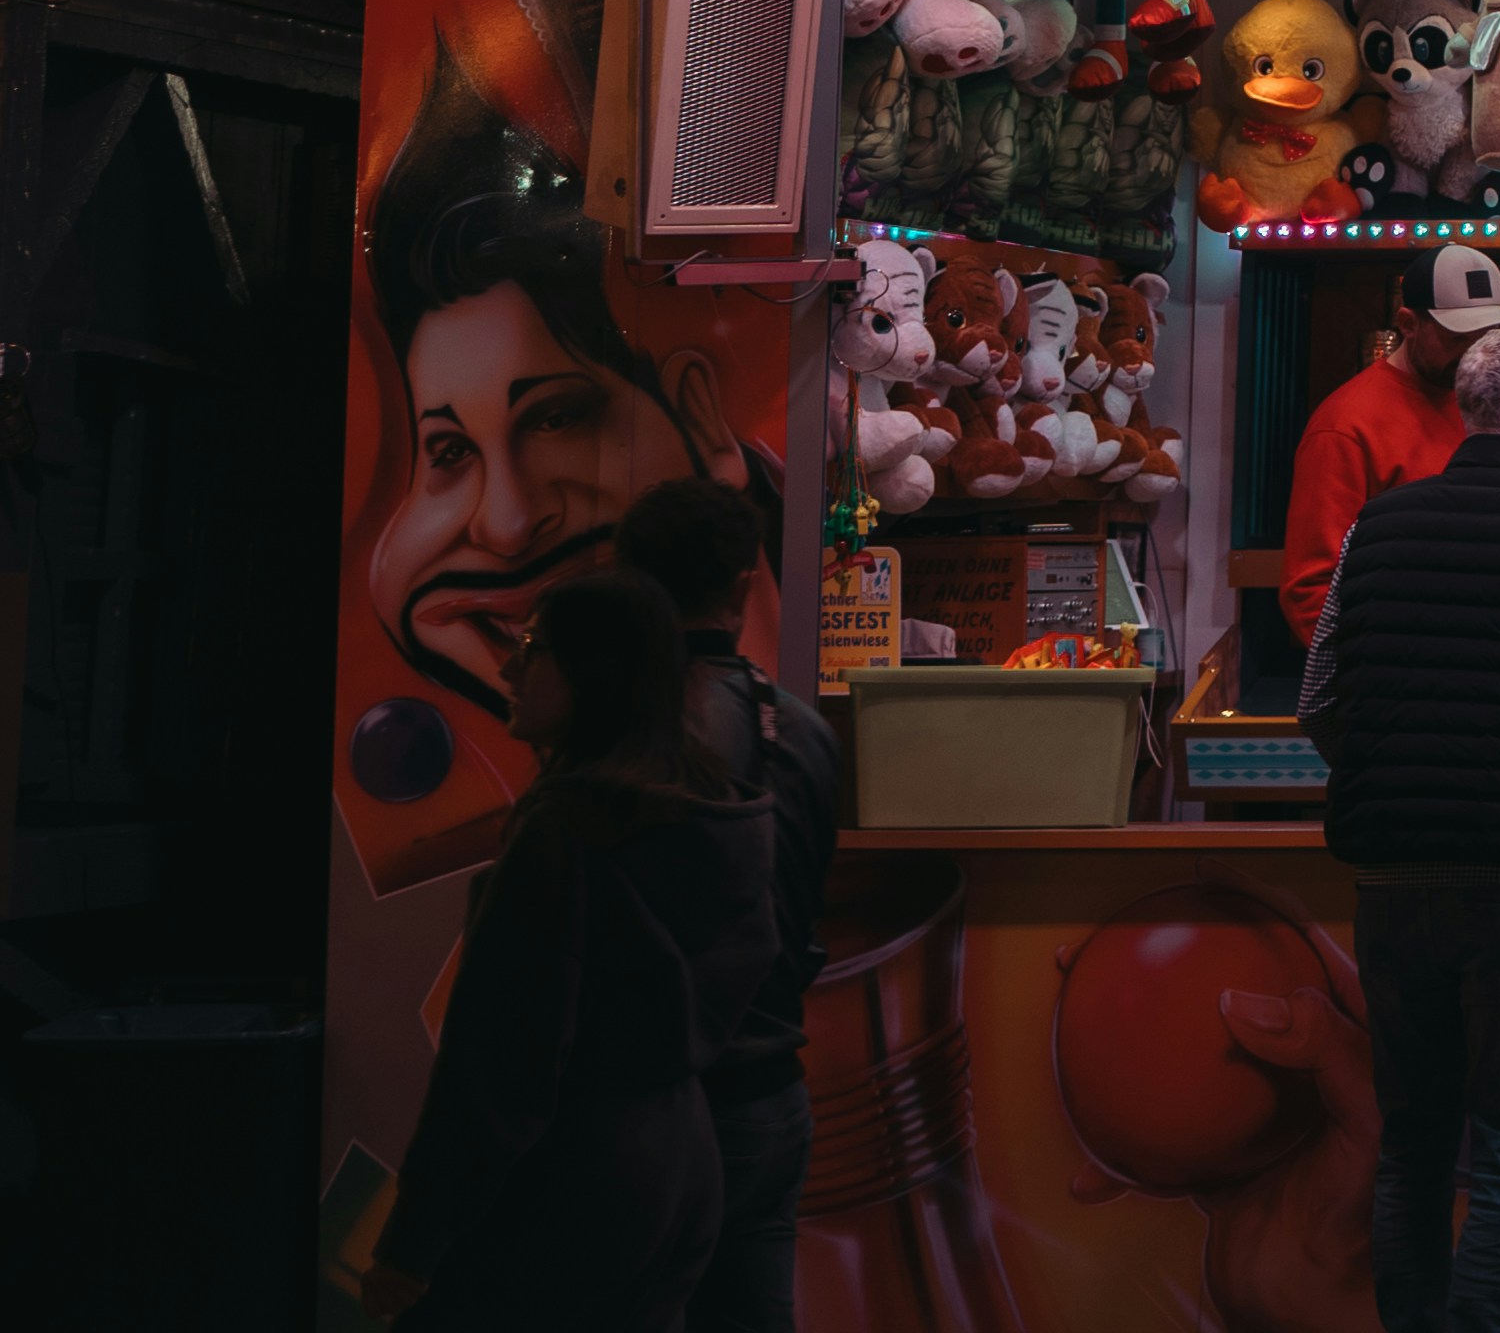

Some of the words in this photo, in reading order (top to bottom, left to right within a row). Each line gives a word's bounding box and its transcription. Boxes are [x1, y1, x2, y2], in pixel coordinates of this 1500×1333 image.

[966, 557, 1013, 575] OHNE
[821, 591, 858, 606] chner
[933, 581, 1015, 603] ANLAGE
[954, 636, 994, 654] NLOS
